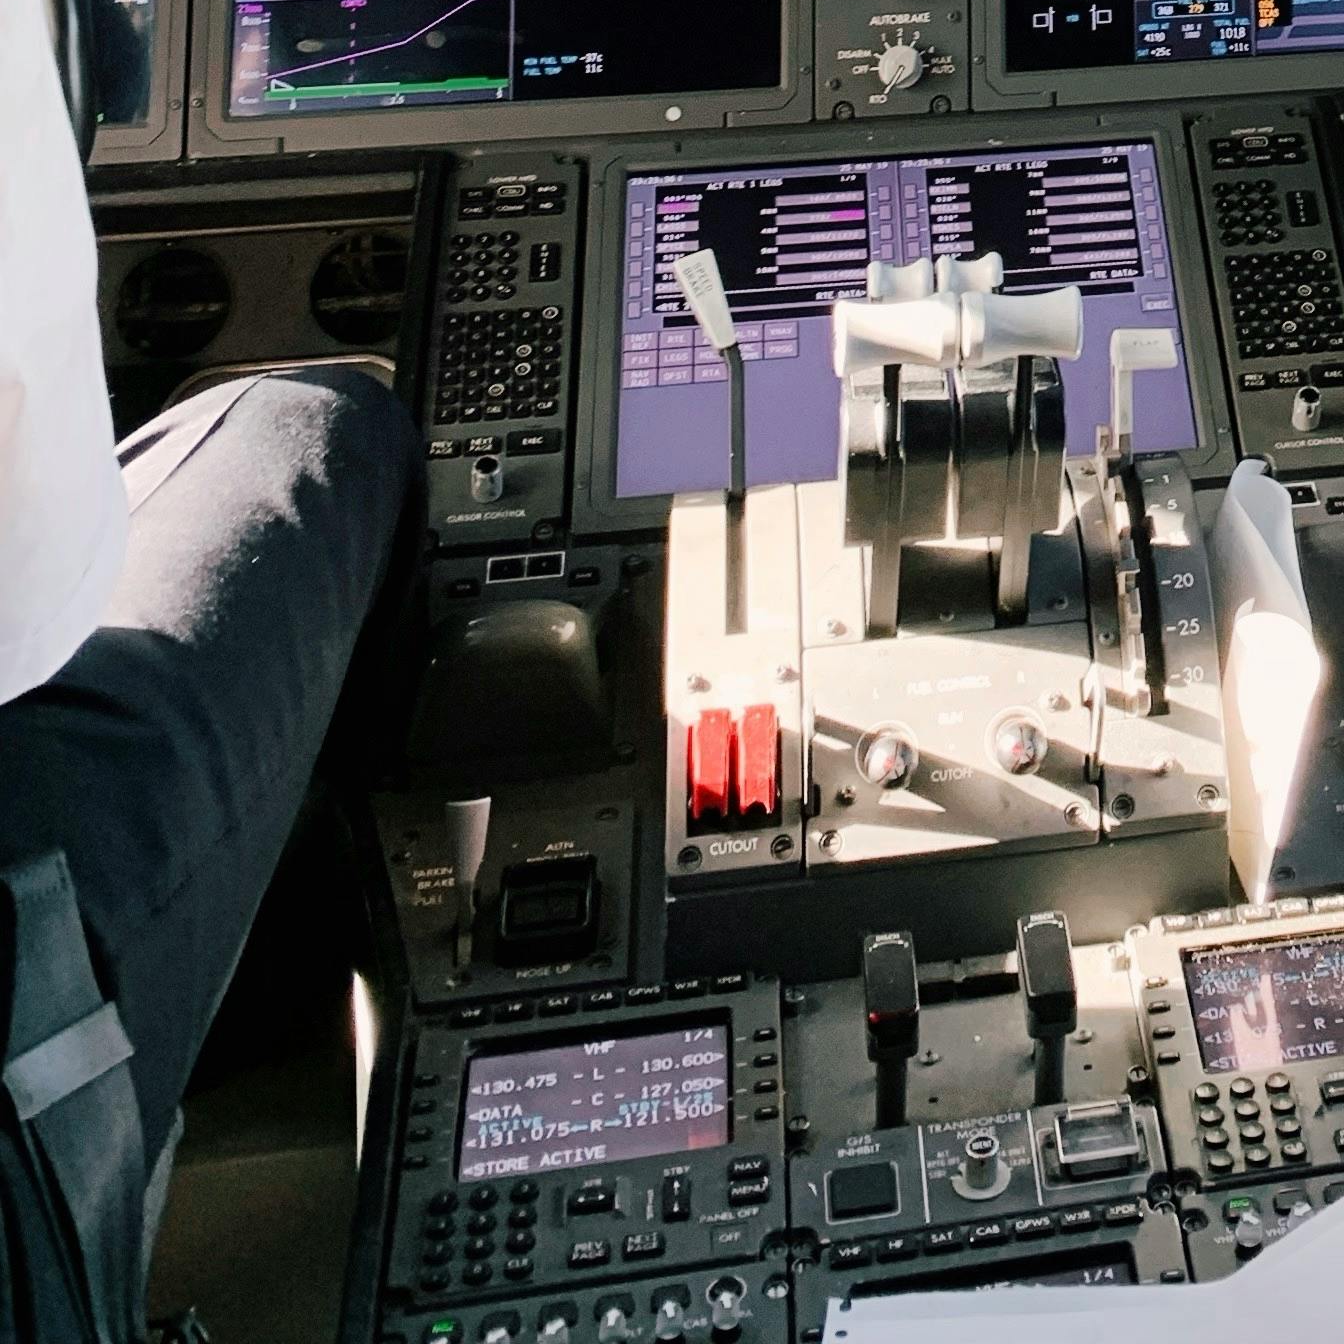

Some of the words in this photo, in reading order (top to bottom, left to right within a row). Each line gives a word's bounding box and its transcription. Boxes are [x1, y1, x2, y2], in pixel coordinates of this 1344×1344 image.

[869, 12, 930, 26] AUTOBRAKE
[1174, 572, 1194, 590] 20
[1181, 619, 1201, 636] 25
[1184, 666, 1204, 683] 30
[930, 767, 975, 783] CUTOFF
[709, 836, 760, 856] CUTOUT
[591, 992, 613, 1001] CAB
[628, 986, 660, 997] GPWS
[584, 1040, 616, 1056] VHF
[481, 1073, 557, 1096] 130.475
[641, 1051, 715, 1074] 130.600
[641, 1077, 714, 1099] 127.050
[479, 1105, 523, 1121] DATA
[479, 1122, 570, 1148] 131.075
[591, 1120, 603, 1132] R
[624, 1103, 714, 1128] 121.500
[928, 1112, 1021, 1134] TRANSPONDER
[847, 1134, 872, 1146] G/S
[957, 1128, 996, 1142] MODE
[473, 1156, 529, 1177] STORE
[540, 1145, 607, 1166] ACTIVE
[734, 1161, 761, 1171] NAV
[731, 1184, 765, 1196] MENU
[976, 1225, 1000, 1237] CAB
[1015, 1216, 1050, 1230] GPWS
[1083, 1268, 1114, 1283] 1/4
